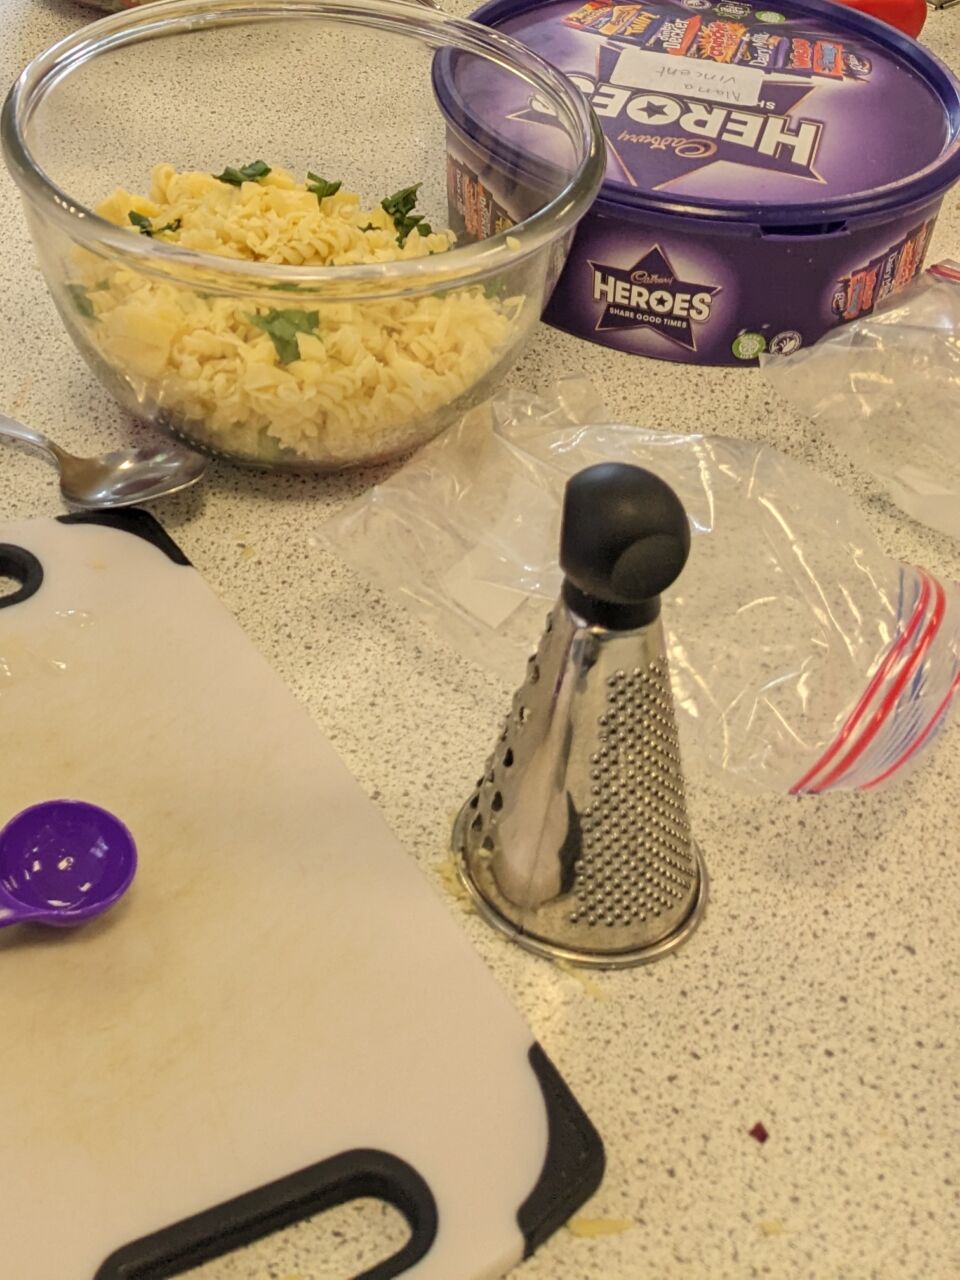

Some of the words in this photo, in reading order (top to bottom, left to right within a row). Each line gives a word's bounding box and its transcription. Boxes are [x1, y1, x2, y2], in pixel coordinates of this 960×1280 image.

[617, 130, 718, 159] Cadbury
[630, 270, 674, 286] Cadbury
[593, 271, 712, 321] HEROES
[609, 307, 635, 320] SHARE
[636, 313, 661, 324] GOOD
[664, 319, 687, 328] TIMES
